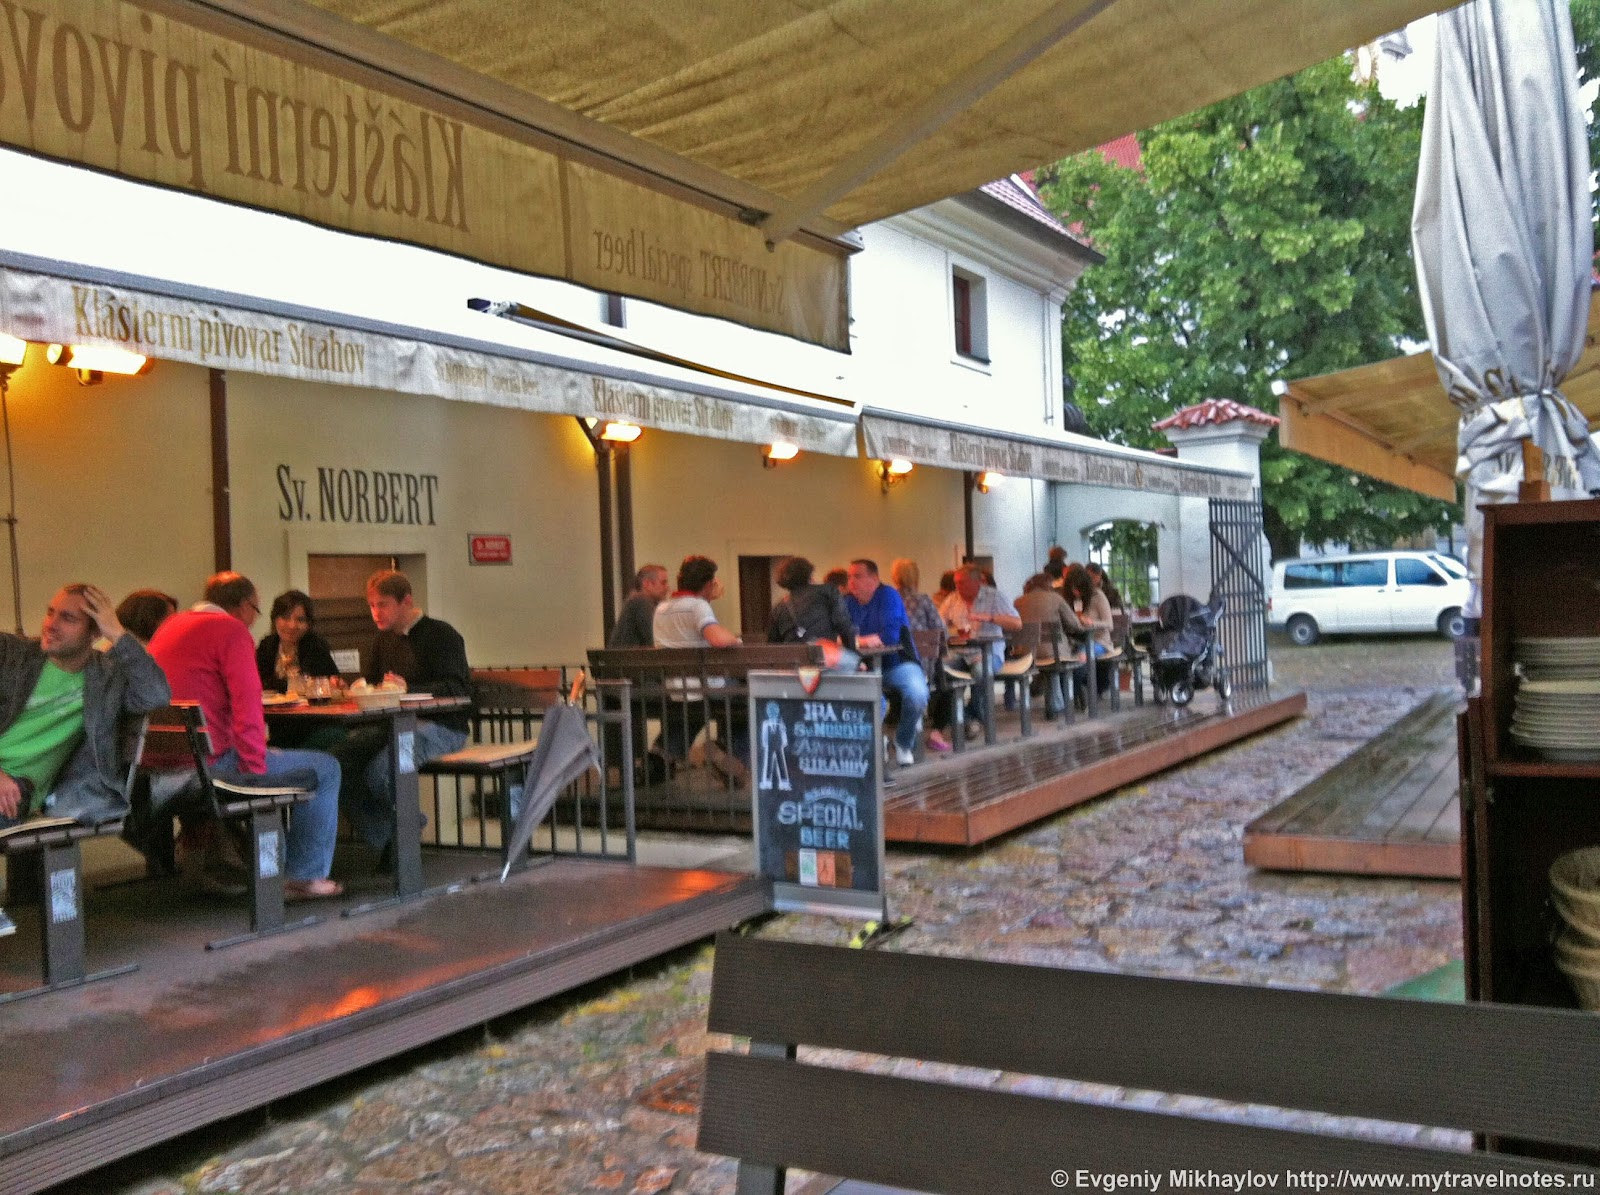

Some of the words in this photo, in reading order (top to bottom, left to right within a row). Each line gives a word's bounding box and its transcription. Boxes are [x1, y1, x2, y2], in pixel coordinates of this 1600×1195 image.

[199, 309, 283, 363] pivovar
[287, 322, 365, 374] Strahov
[276, 463, 312, 522] Sv.
[317, 467, 438, 526] NORBERT
[803, 701, 838, 721] IPA
[800, 826, 849, 850] BEER
